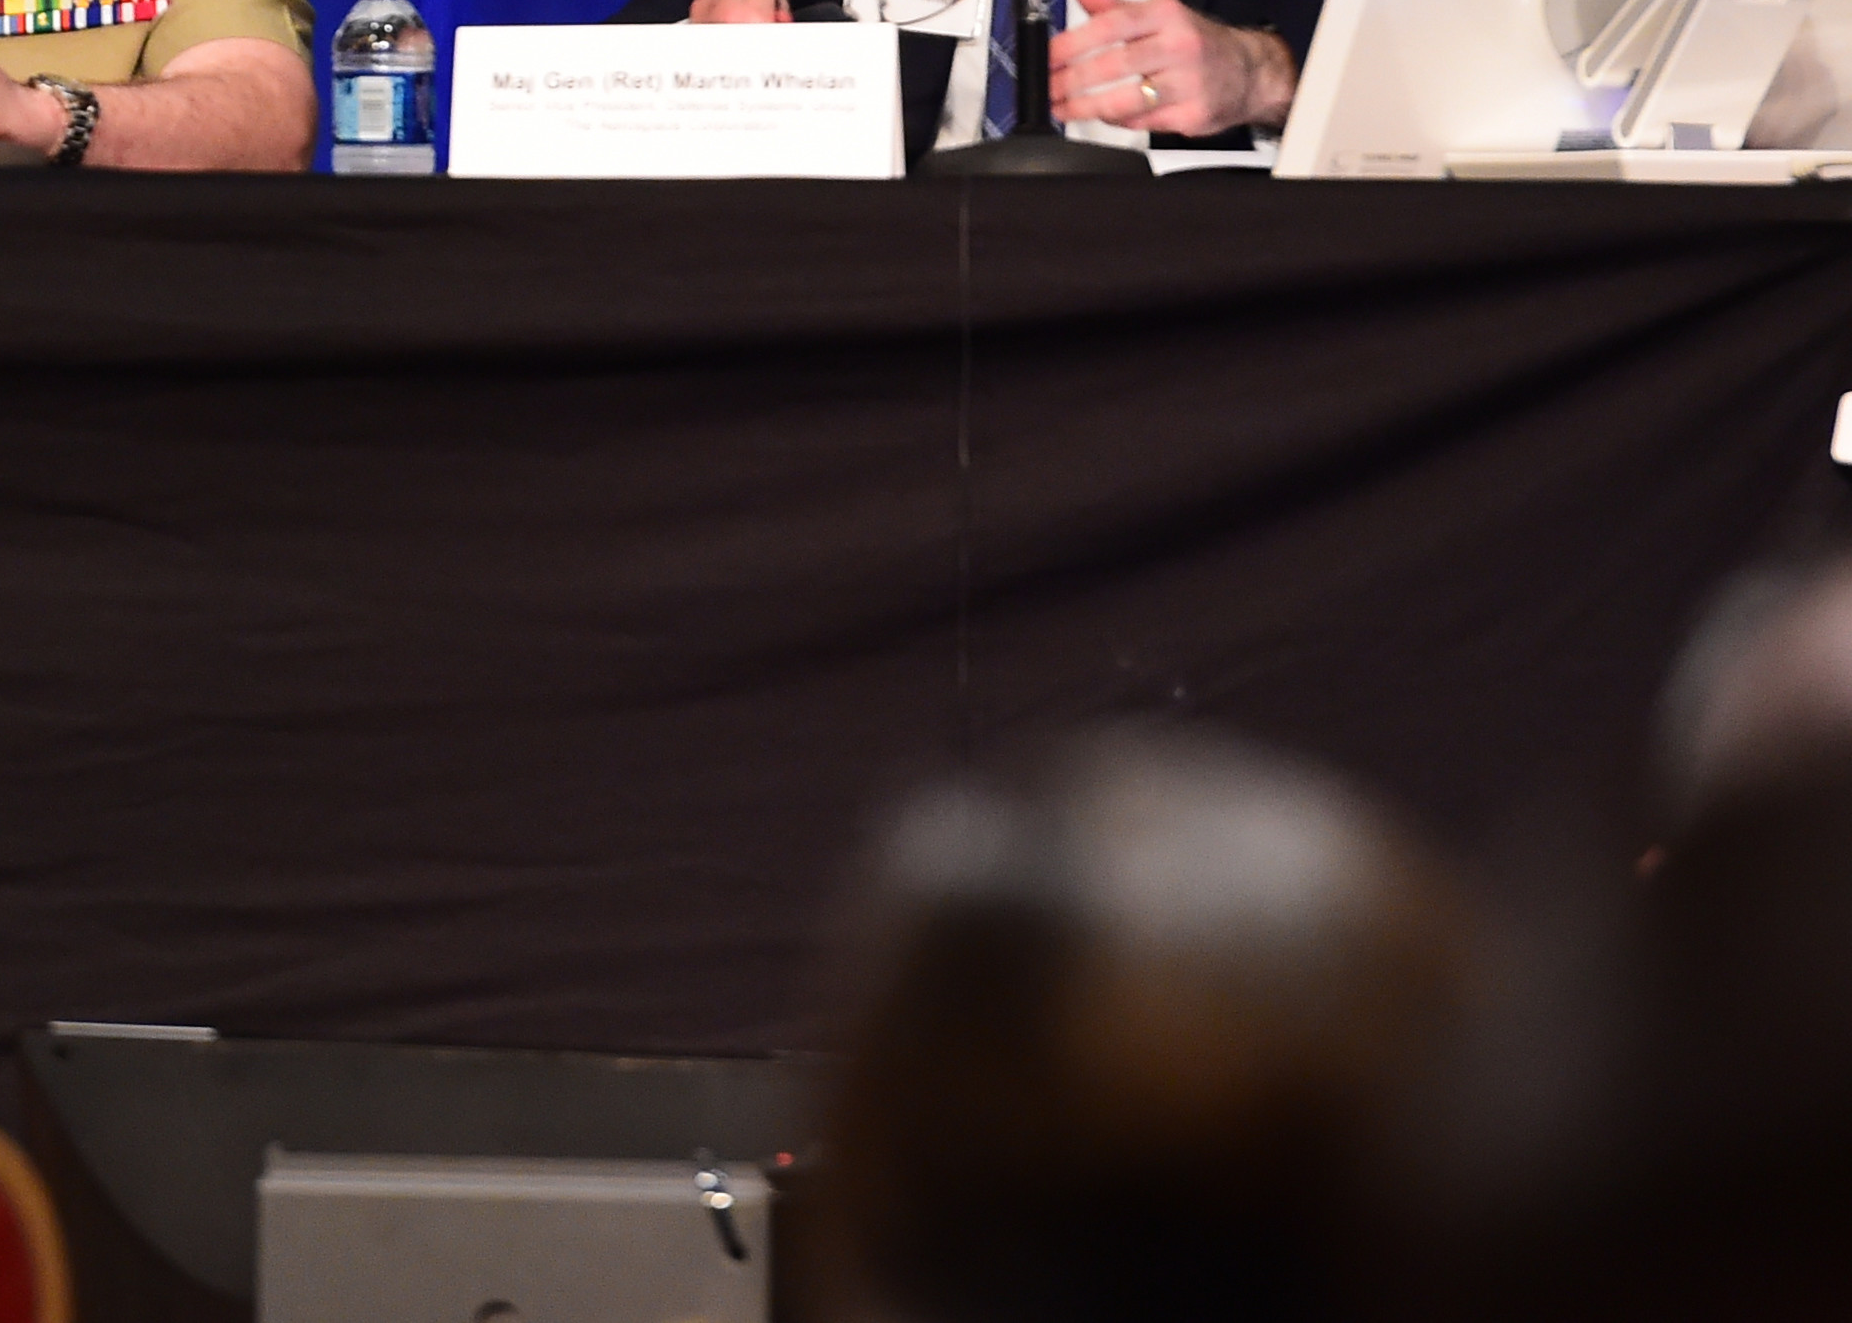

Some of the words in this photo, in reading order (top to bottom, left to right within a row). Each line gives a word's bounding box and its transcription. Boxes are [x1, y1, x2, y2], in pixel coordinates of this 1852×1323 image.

[492, 71, 535, 95] Maj
[543, 71, 595, 90] Gen
[603, 70, 663, 94] (Ret)
[672, 71, 752, 89] Martin
[761, 71, 856, 90] Whelan
